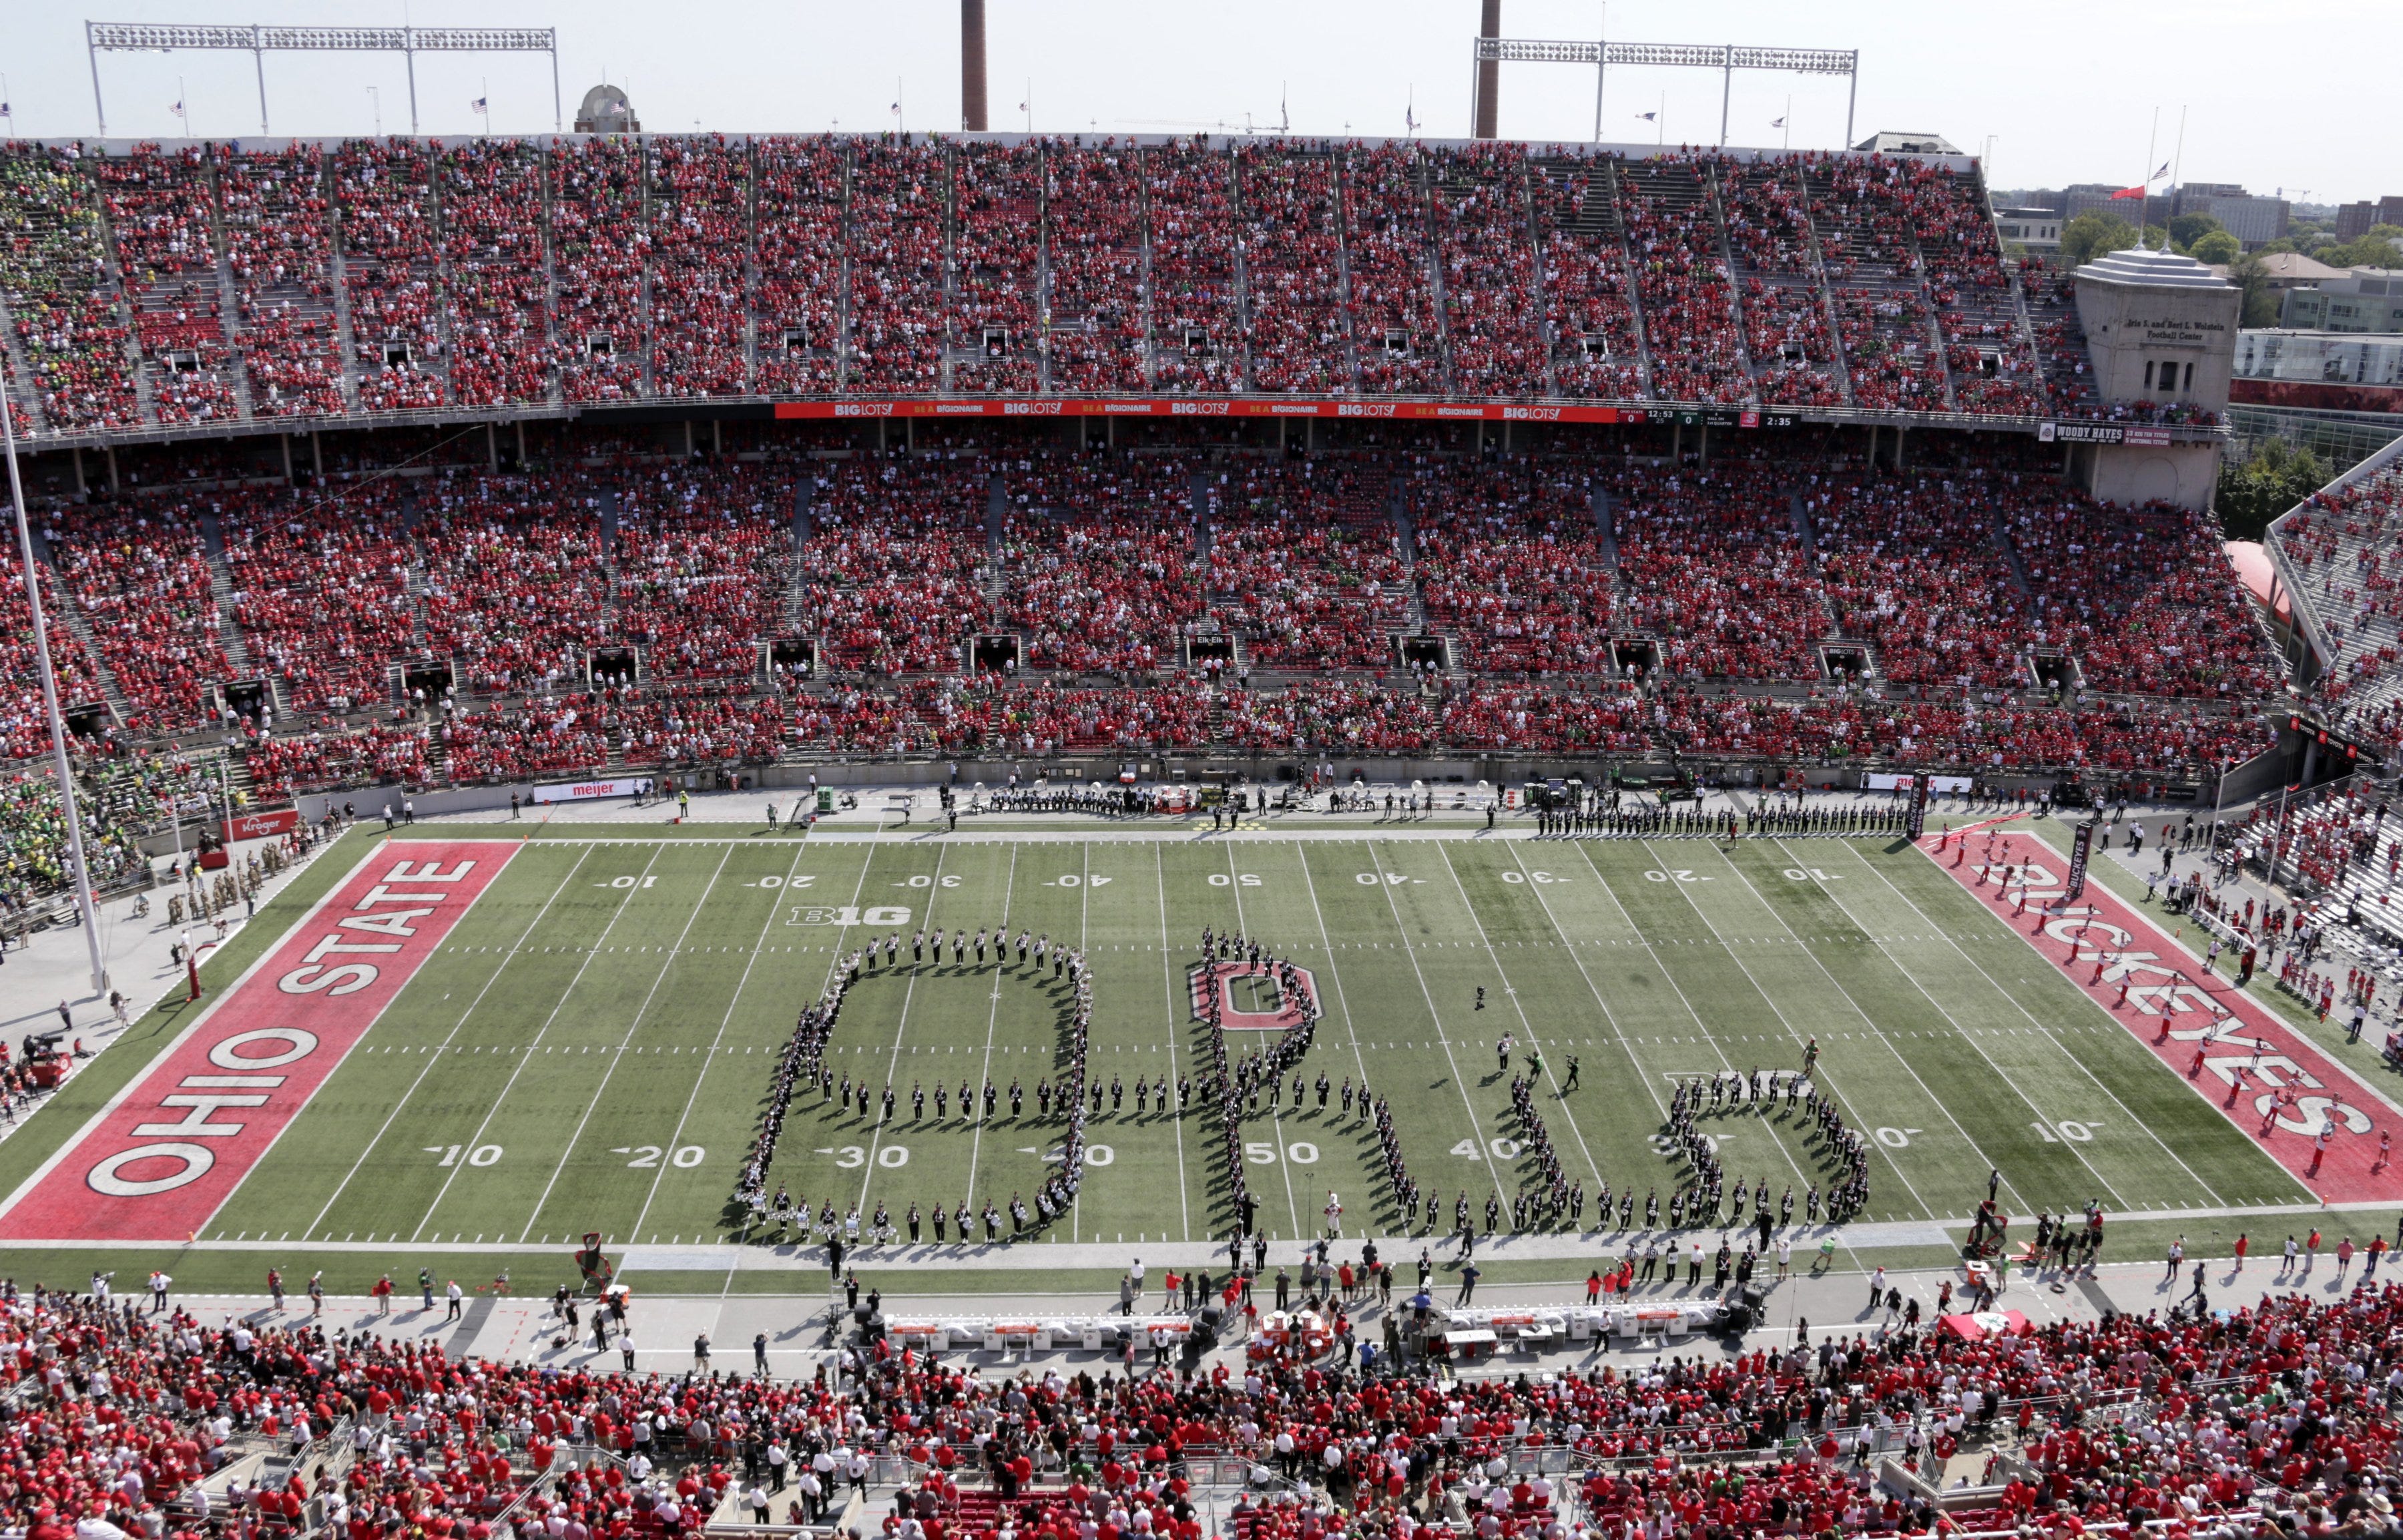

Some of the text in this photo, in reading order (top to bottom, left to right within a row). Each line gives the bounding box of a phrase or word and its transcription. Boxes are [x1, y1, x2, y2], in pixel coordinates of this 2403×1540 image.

[2194, 322, 2224, 331] Wolstein
[2147, 330, 2176, 339] Football
[1767, 417, 1791, 425] 2:35
[2057, 426, 2123, 439] WOODY HAYES
[2299, 724, 2315, 736] TOYOTA
[2327, 737, 2344, 750] TOYOTA
[573, 782, 614, 797] meijer
[1909, 786, 1920, 830] BUCKEYES
[242, 817, 280, 835] Kroger
[2070, 840, 2085, 888] BUCKEYES
[1059, 874, 1112, 887] 40
[1208, 874, 1262, 886] 50
[1356, 872, 1408, 885] 40
[1501, 871, 1554, 884] 30
[1643, 870, 1697, 882] 20
[1783, 868, 1830, 880] 10
[611, 876, 658, 888] 10
[760, 876, 816, 888] 20
[909, 875, 962, 887] 30
[278, 860, 478, 997] STATE
[1972, 863, 2374, 1137] BUCKEYES
[85, 1027, 320, 1198] OHIO
[2030, 1120, 2093, 1143] 10
[1245, 1142, 1320, 1164] 50
[1450, 1137, 1521, 1160] 40
[437, 1144, 503, 1167] 10
[627, 1145, 706, 1168] 20
[836, 1145, 910, 1168] 30
[1270, 1332, 1280, 1342] G
[1579, 1393, 1587, 1401] 33
[1318, 1434, 1324, 1443] 3
[1942, 1442, 1949, 1450] 2
[470, 1455, 479, 1465] 16
[684, 1514, 694, 1525] 15
